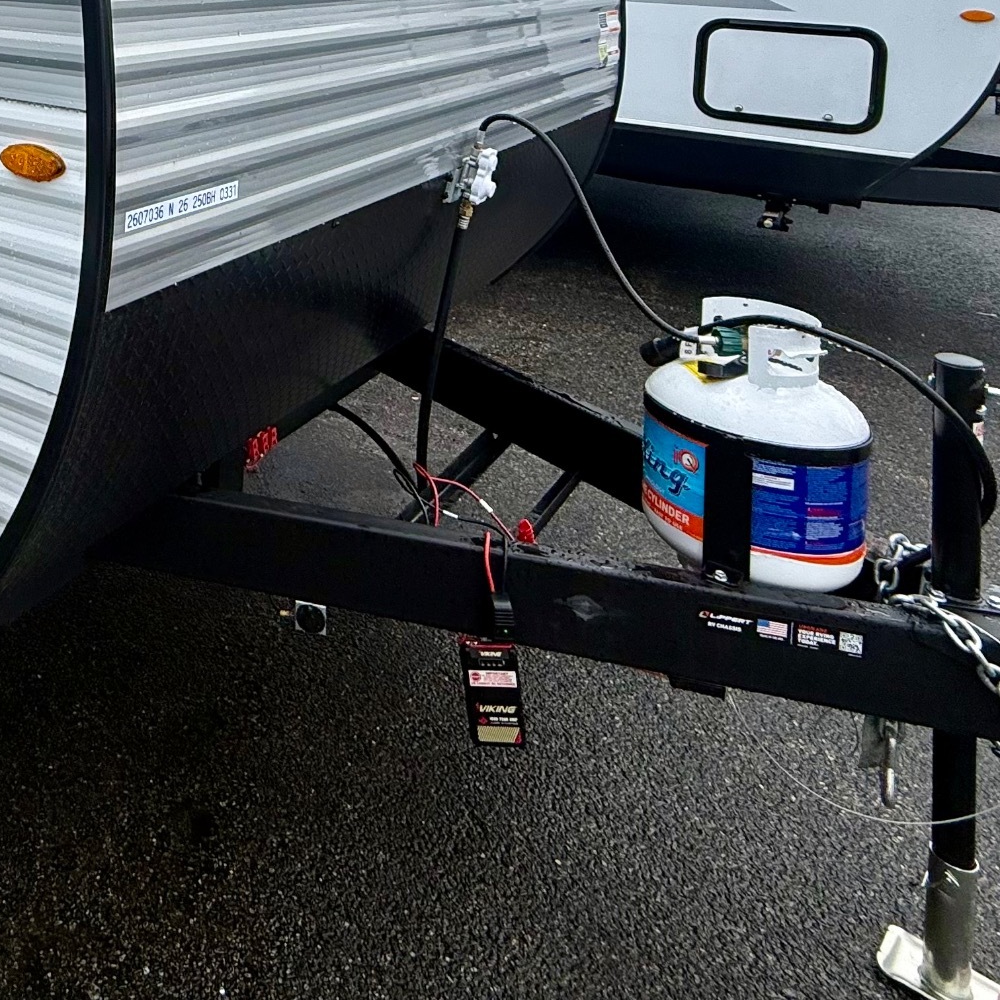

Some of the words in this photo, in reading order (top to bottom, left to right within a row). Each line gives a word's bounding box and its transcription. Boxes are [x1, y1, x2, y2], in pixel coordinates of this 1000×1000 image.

[127, 204, 164, 229] 2607036
[168, 202, 174, 216] N
[178, 198, 189, 214] 26
[192, 190, 217, 209] 250BH
[219, 184, 238, 201] 0331
[647, 489, 690, 526] CYLINDER
[709, 612, 754, 625] LIPPERT
[716, 622, 742, 633] CHASSIS
[479, 704, 518, 714] VIKING
